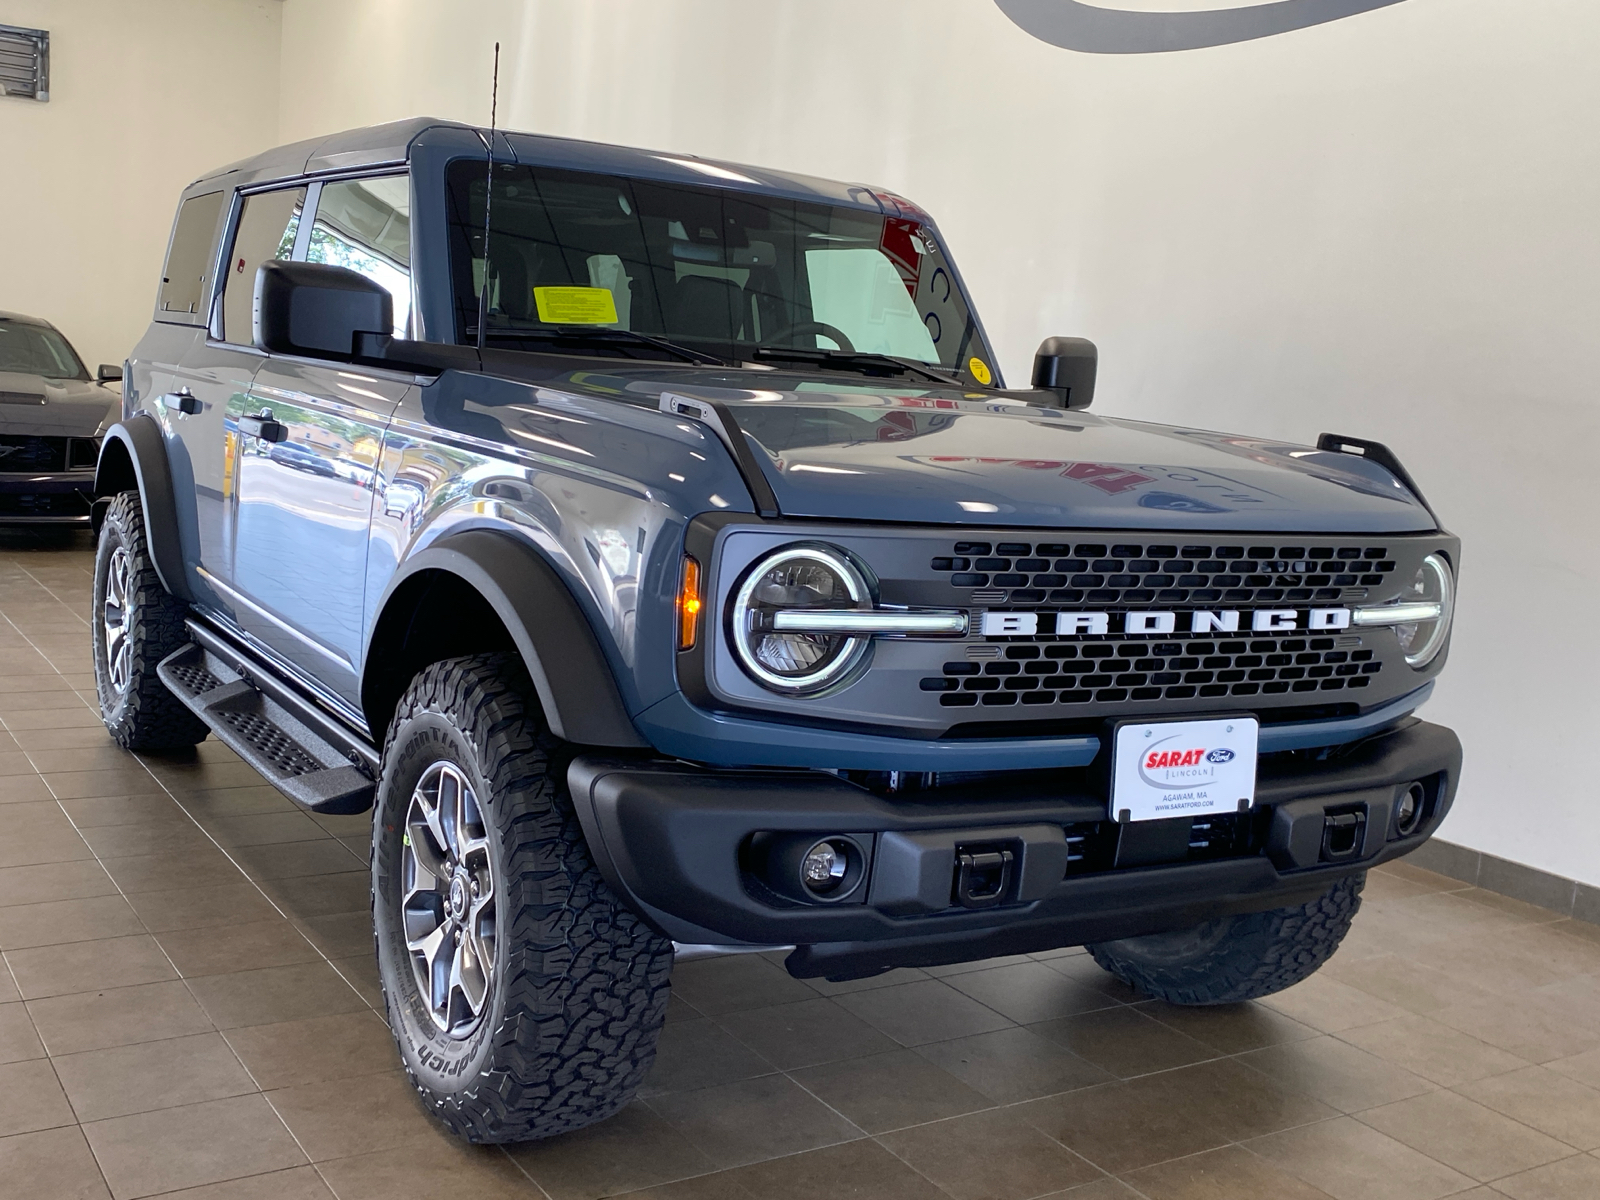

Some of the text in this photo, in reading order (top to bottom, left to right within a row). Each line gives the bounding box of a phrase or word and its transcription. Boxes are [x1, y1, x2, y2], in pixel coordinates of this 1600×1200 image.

[980, 608, 1351, 636] BRONCO
[1145, 748, 1232, 769] SARAT Ford
[1171, 769, 1208, 778] LINCOLN
[1162, 793, 1195, 802] AGAWAM,
[1155, 800, 1214, 811] WWW.SARATFORD.COM
